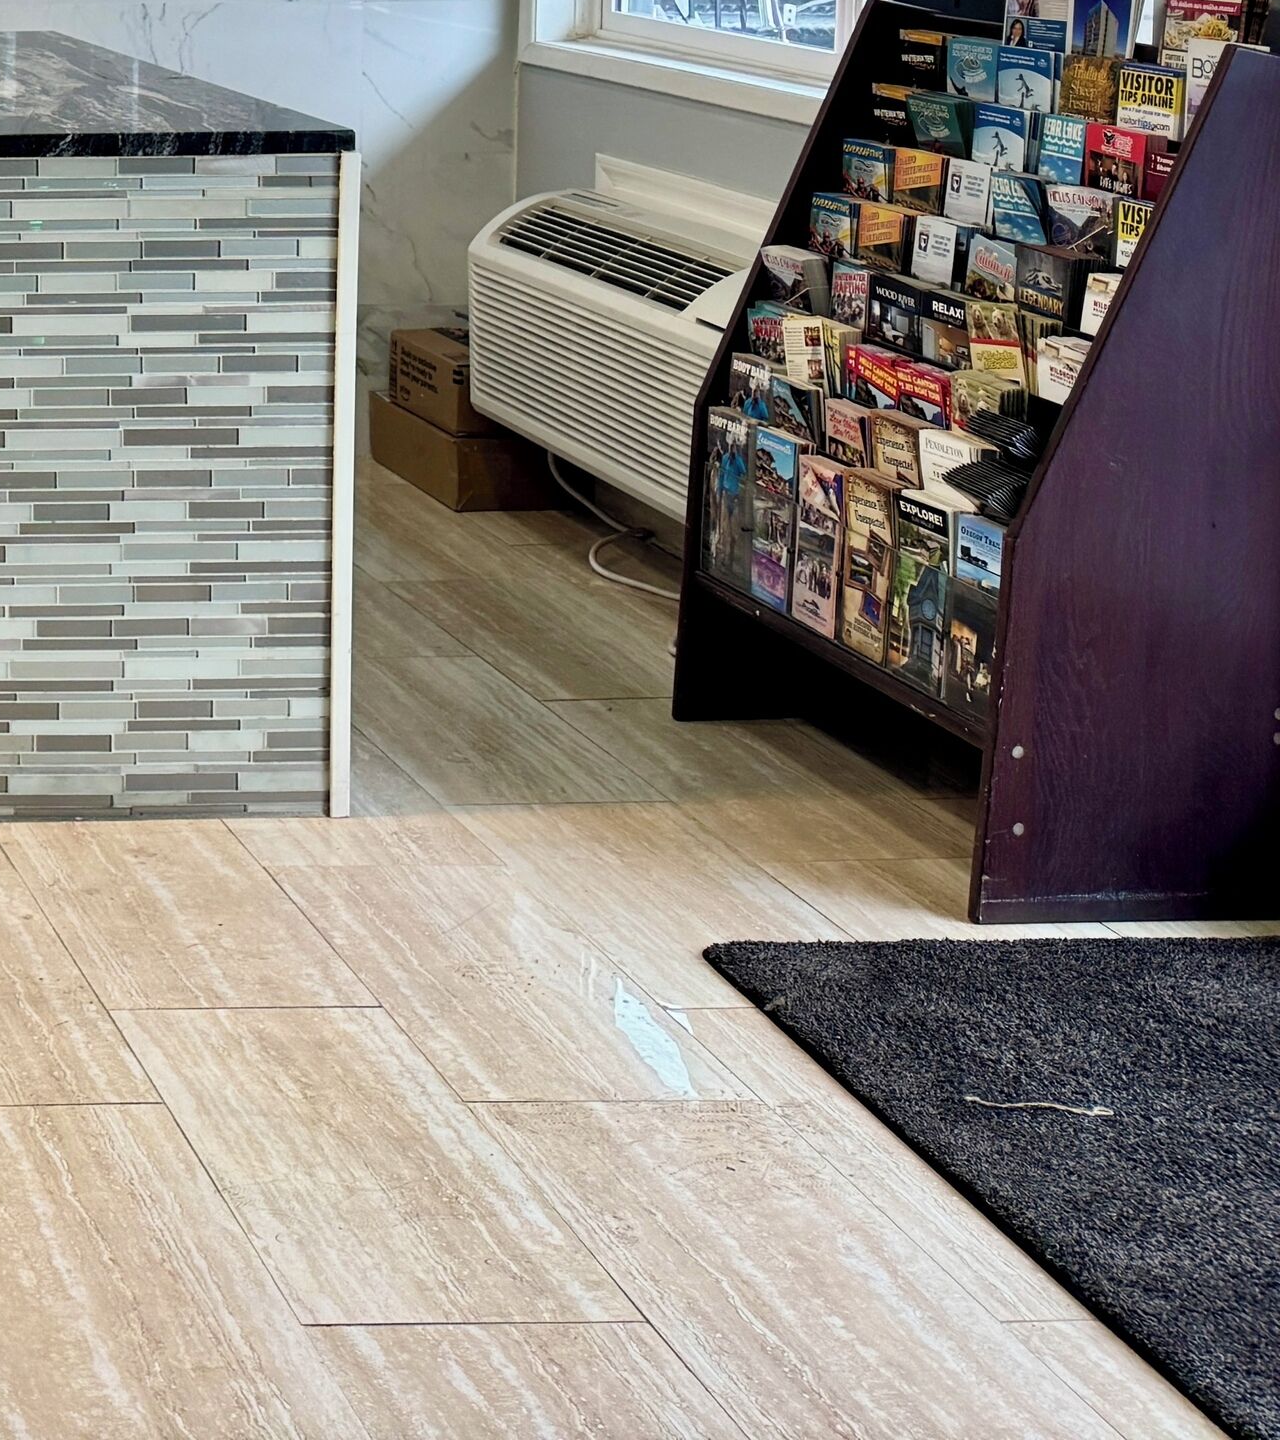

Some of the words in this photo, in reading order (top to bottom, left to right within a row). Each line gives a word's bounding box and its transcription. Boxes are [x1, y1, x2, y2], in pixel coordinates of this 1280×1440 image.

[1122, 71, 1174, 97] VISITOR
[1140, 93, 1174, 109] ONLINE
[1121, 222, 1141, 237] TIPS
[932, 300, 964, 320] RELAX!
[1018, 287, 1065, 317] LEGENDARY
[924, 436, 965, 459] PENDLETON
[899, 500, 944, 527] EXPLORE!
